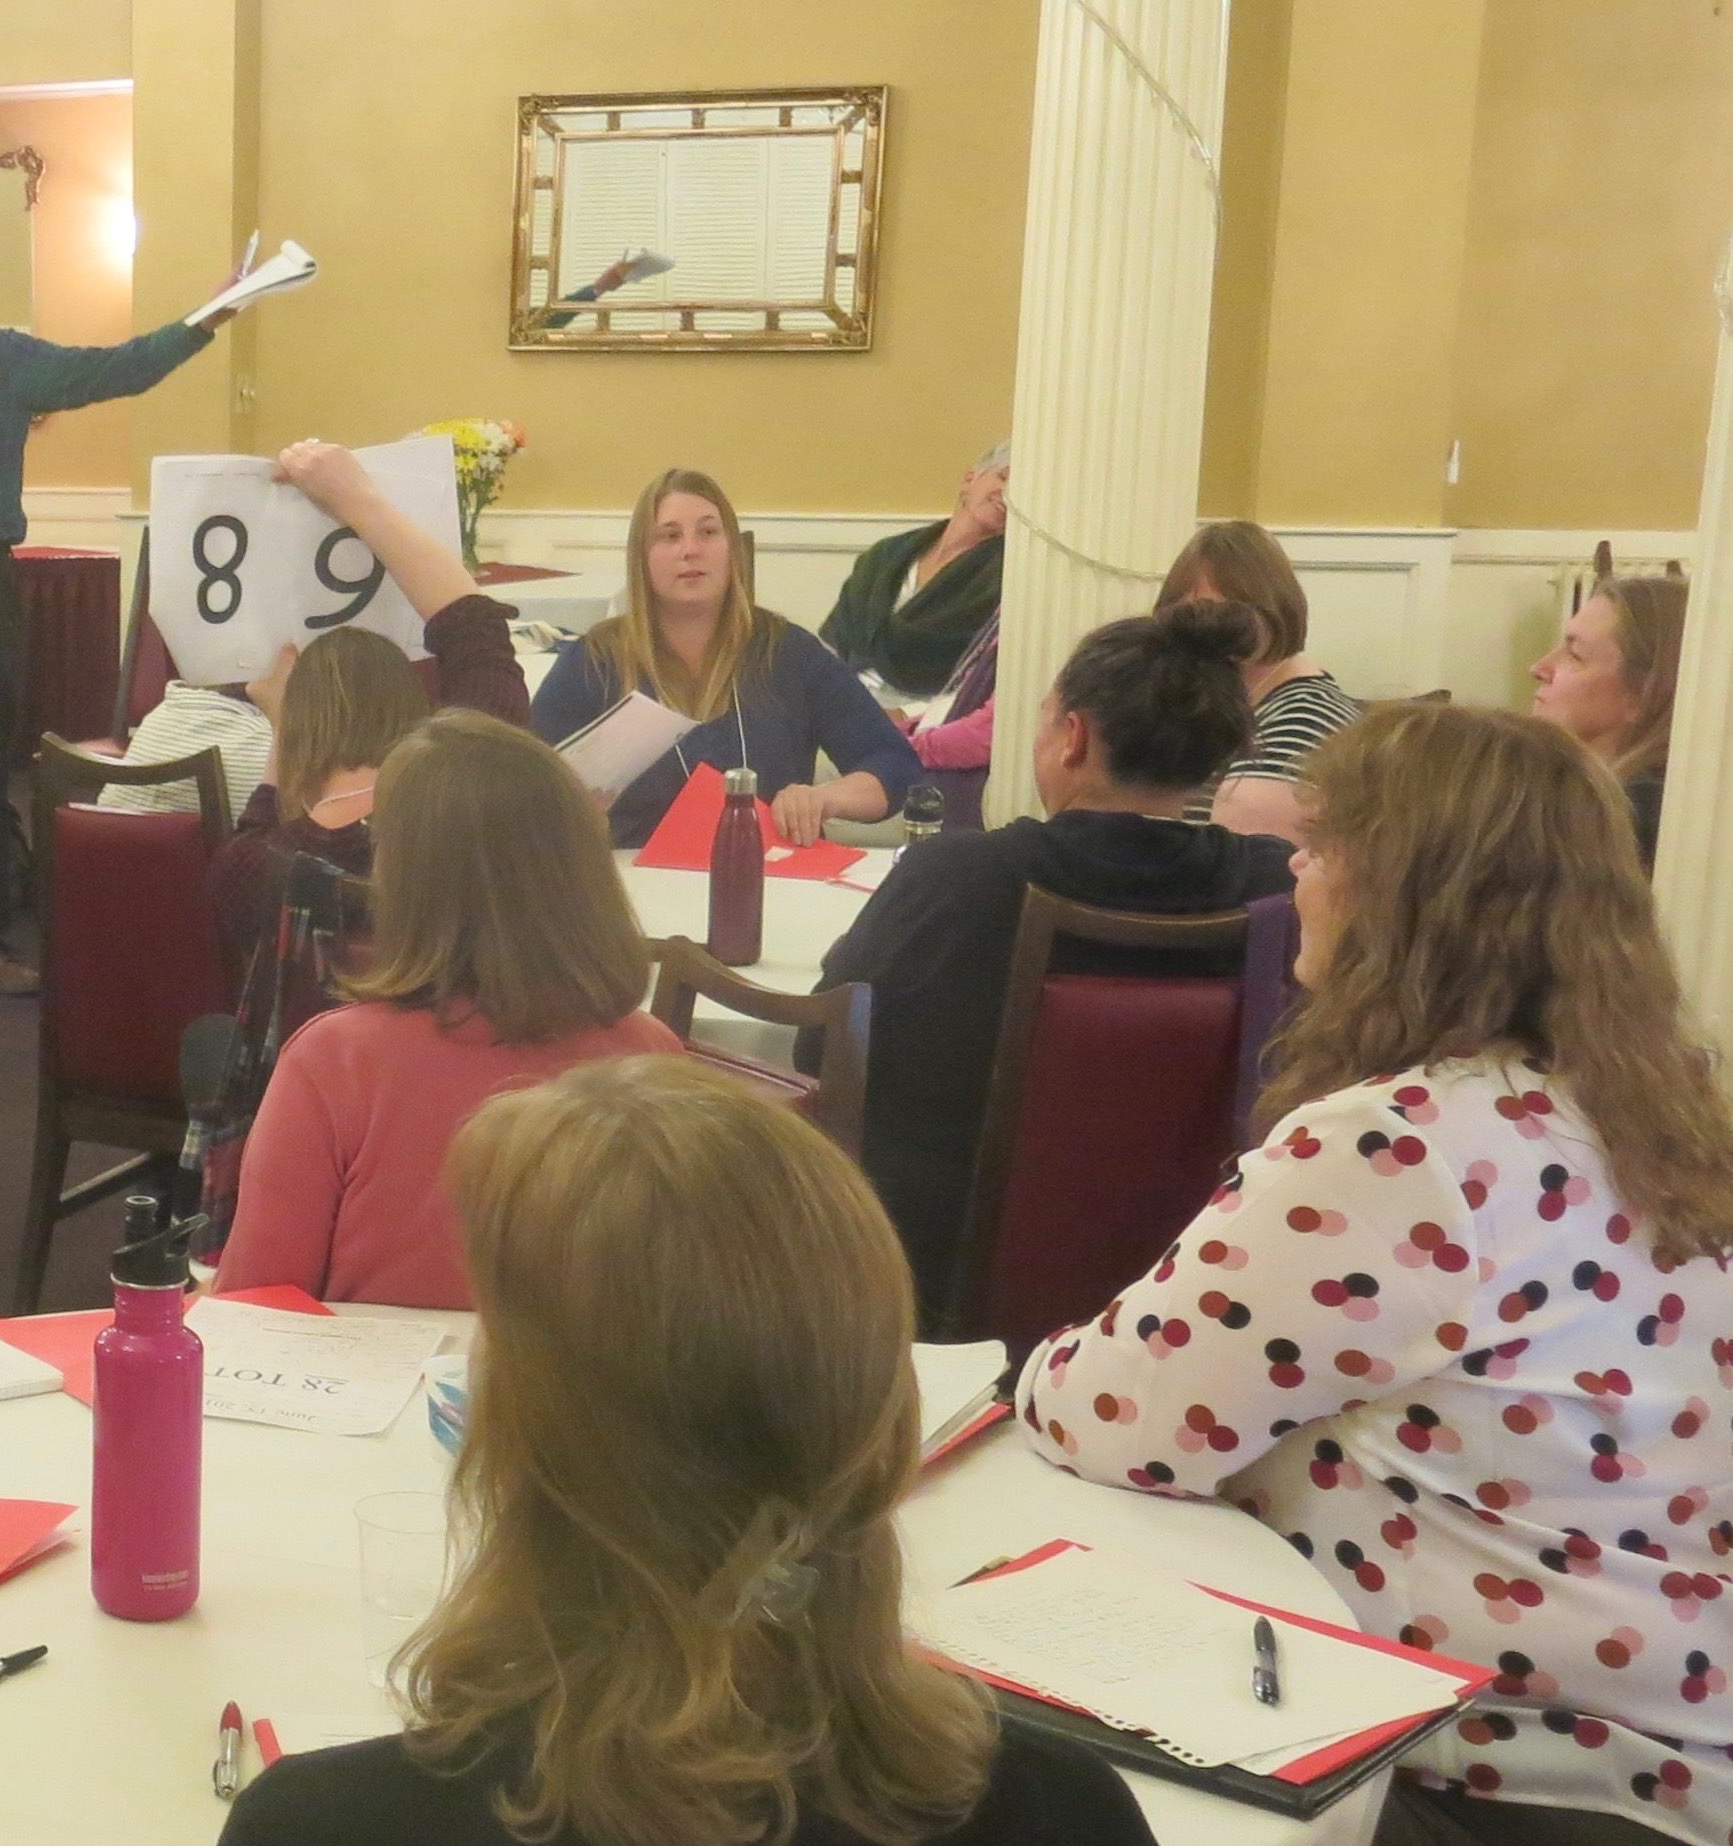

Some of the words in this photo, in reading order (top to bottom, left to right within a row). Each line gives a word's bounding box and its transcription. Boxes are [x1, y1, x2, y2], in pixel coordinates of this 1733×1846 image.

[192, 514, 248, 624] 8
[304, 526, 386, 629] 9
[302, 1377, 347, 1395] 28
